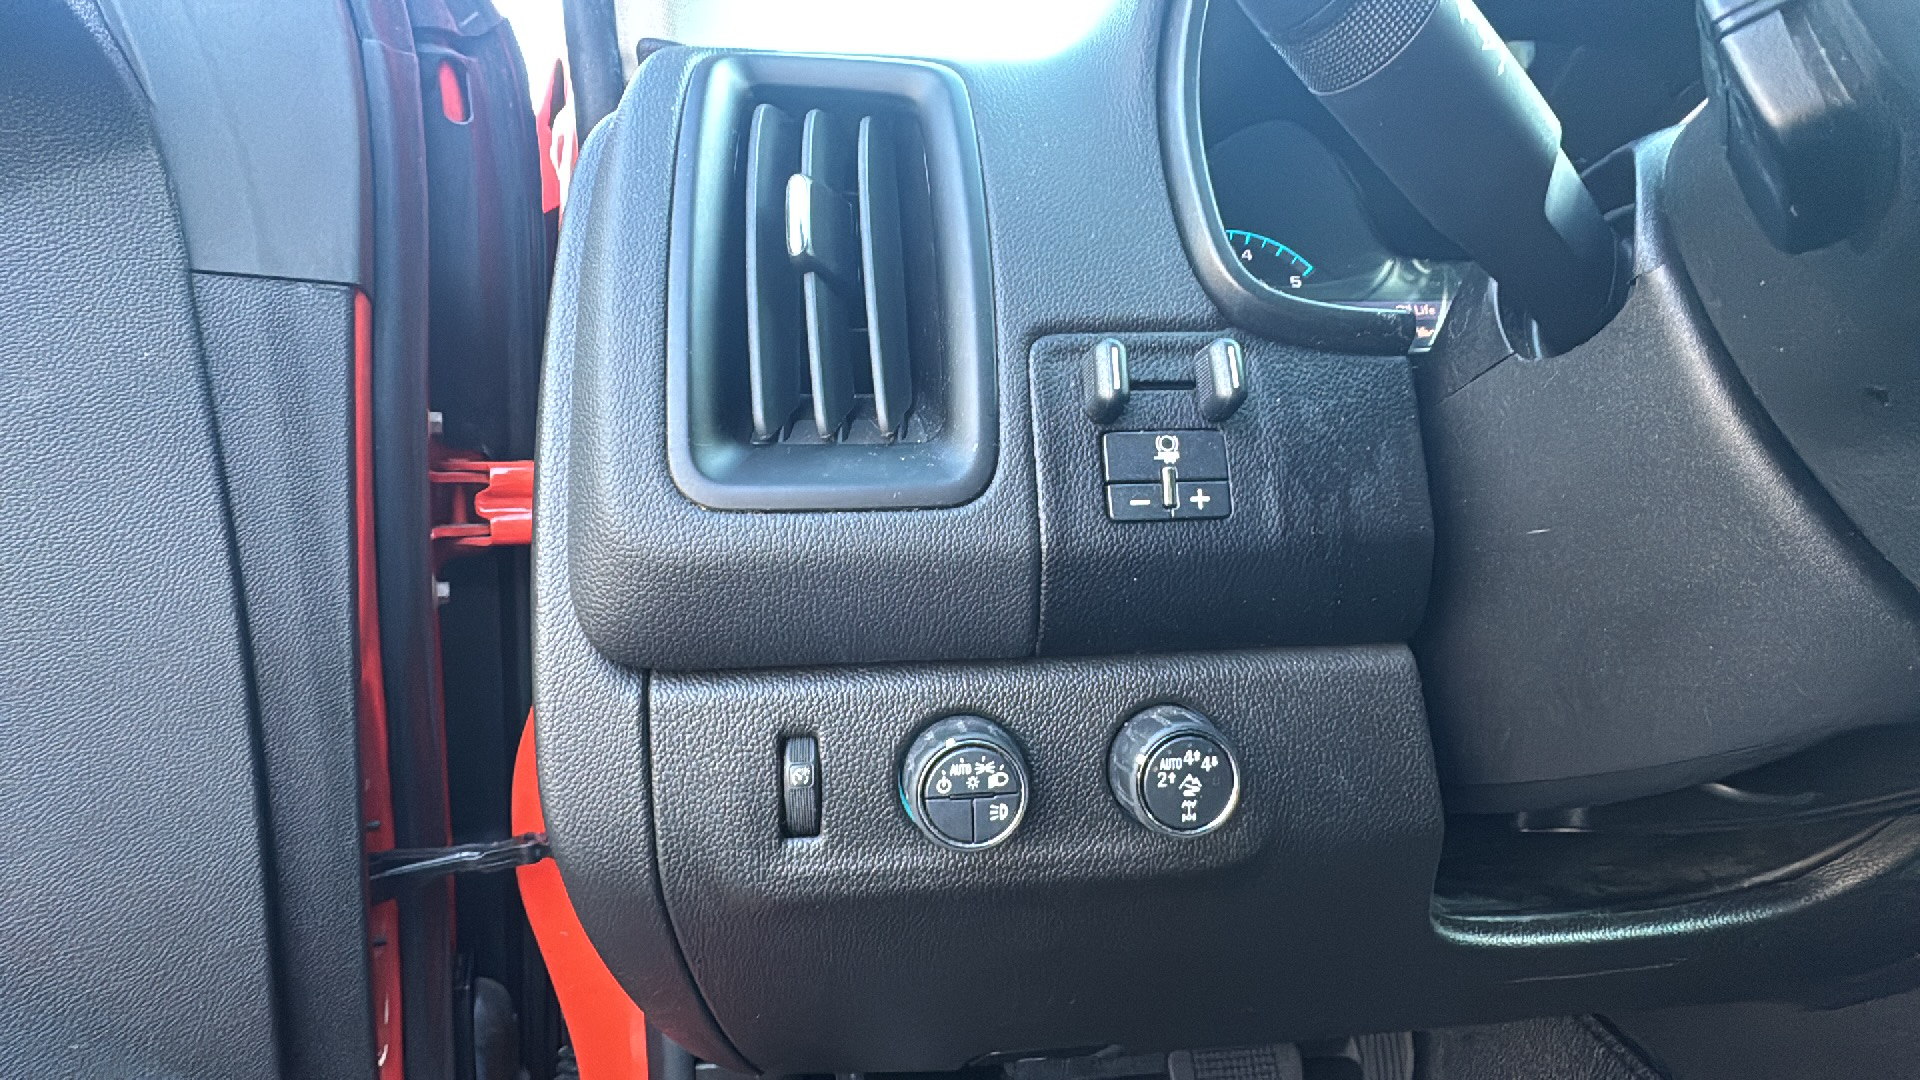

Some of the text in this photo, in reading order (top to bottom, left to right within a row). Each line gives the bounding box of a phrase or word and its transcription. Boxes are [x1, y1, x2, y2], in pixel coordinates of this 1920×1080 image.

[1241, 249, 1253, 261] 4
[1289, 275, 1302, 289] 5
[1413, 304, 1435, 316] Life
[1160, 757, 1183, 771] AUTO
[1183, 749, 1194, 766] 4
[1201, 755, 1212, 772] 4
[949, 763, 972, 776] AUTO
[1157, 771, 1168, 788] 2
